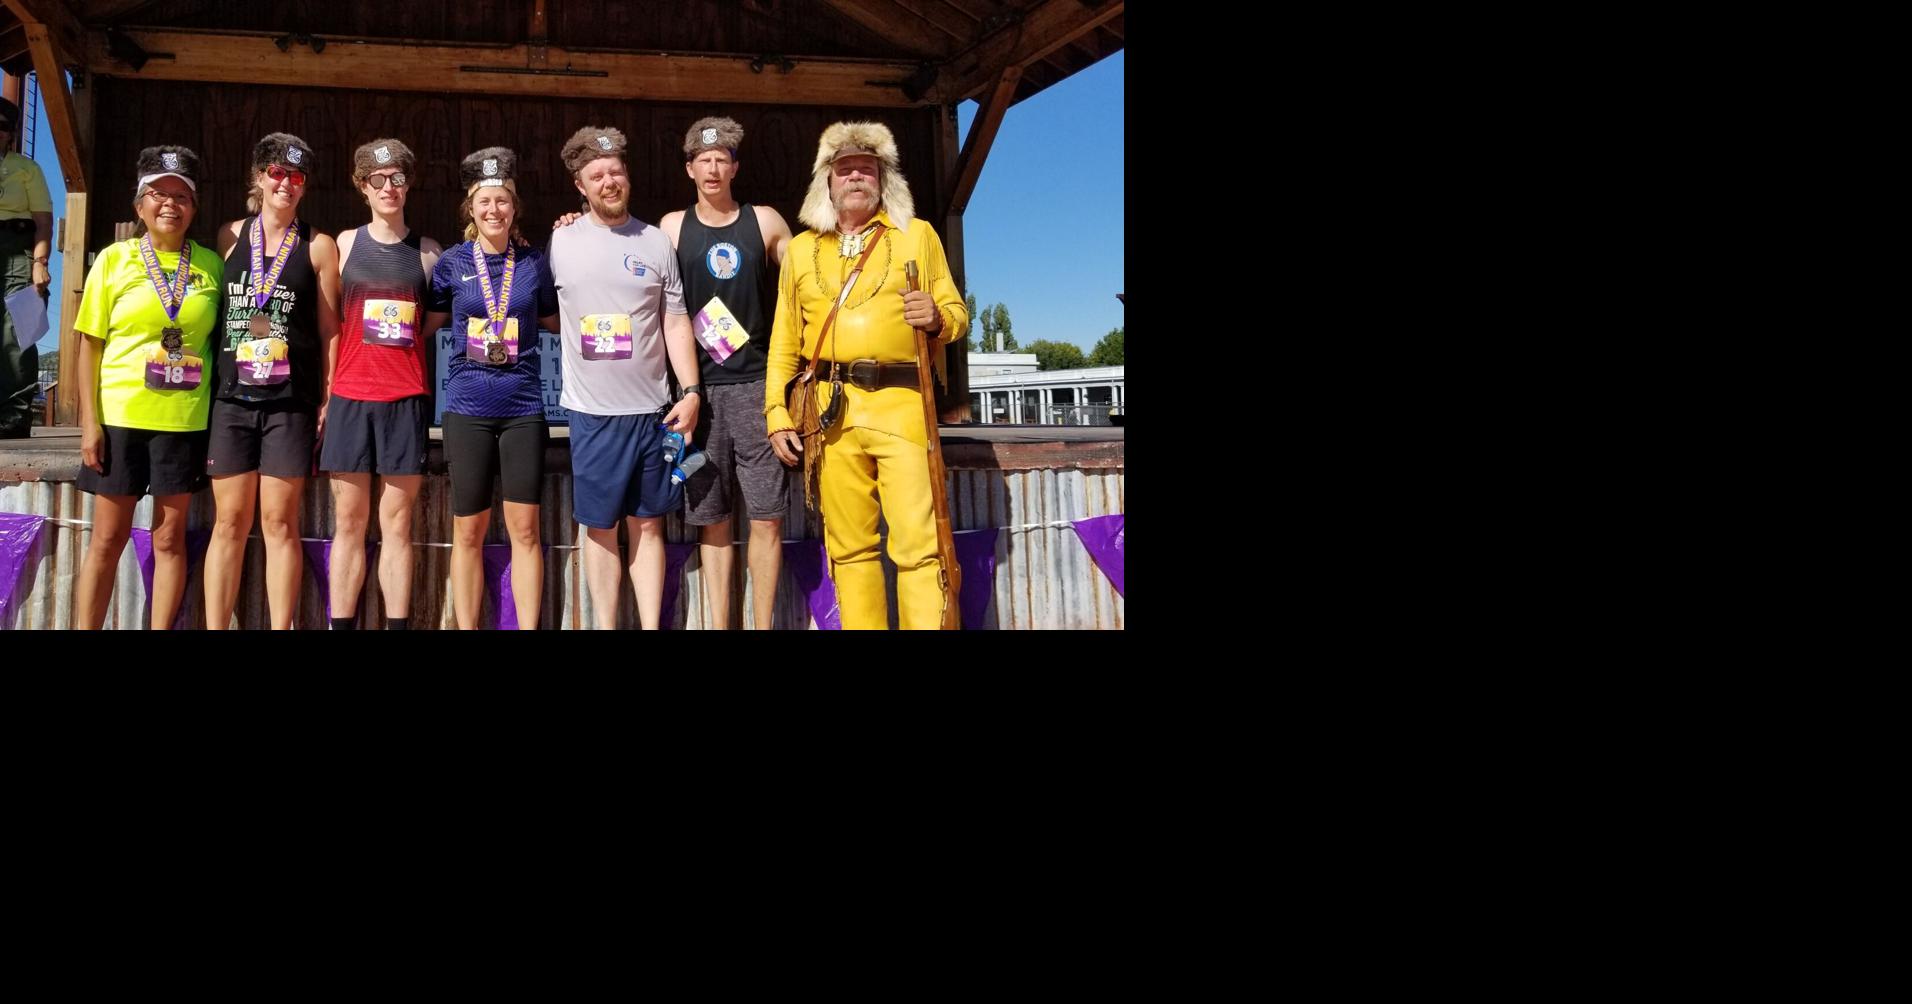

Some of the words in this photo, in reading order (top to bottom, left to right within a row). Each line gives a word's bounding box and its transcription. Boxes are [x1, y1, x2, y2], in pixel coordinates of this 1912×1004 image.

[253, 249, 261, 271] MAN
[262, 246, 290, 295] MOUNTAIN
[150, 267, 165, 287] MAN
[158, 286, 173, 308] RUN
[172, 262, 189, 307] MOUNTAIN
[254, 272, 263, 294] RUN
[229, 295, 249, 307] THAN
[282, 301, 295, 313] OF
[480, 276, 492, 299] MAN
[486, 301, 497, 322] RUN
[497, 270, 513, 322] MOUNTAIN
[377, 321, 401, 339] 33
[594, 336, 616, 353] 22
[163, 366, 185, 384] 18
[252, 361, 274, 379] 27
